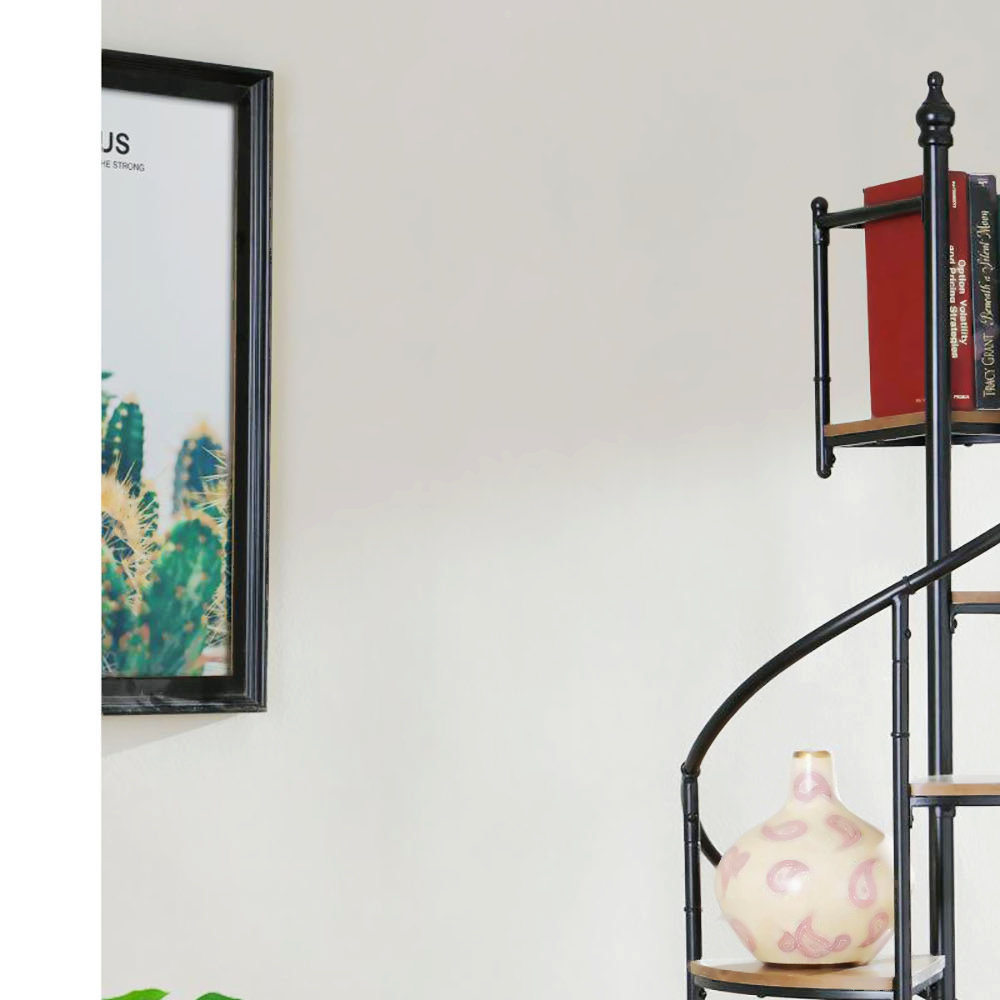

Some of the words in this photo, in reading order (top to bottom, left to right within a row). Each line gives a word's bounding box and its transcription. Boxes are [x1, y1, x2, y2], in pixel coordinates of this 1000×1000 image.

[112, 160, 145, 172] STRONG
[977, 240, 995, 273] Silent
[957, 259, 967, 295] Option
[979, 281, 995, 325] Beneath
[949, 305, 960, 359] Strategies
[959, 299, 969, 345] Volatility
[981, 332, 996, 366] GRANT
[982, 368, 996, 397] TRACY
